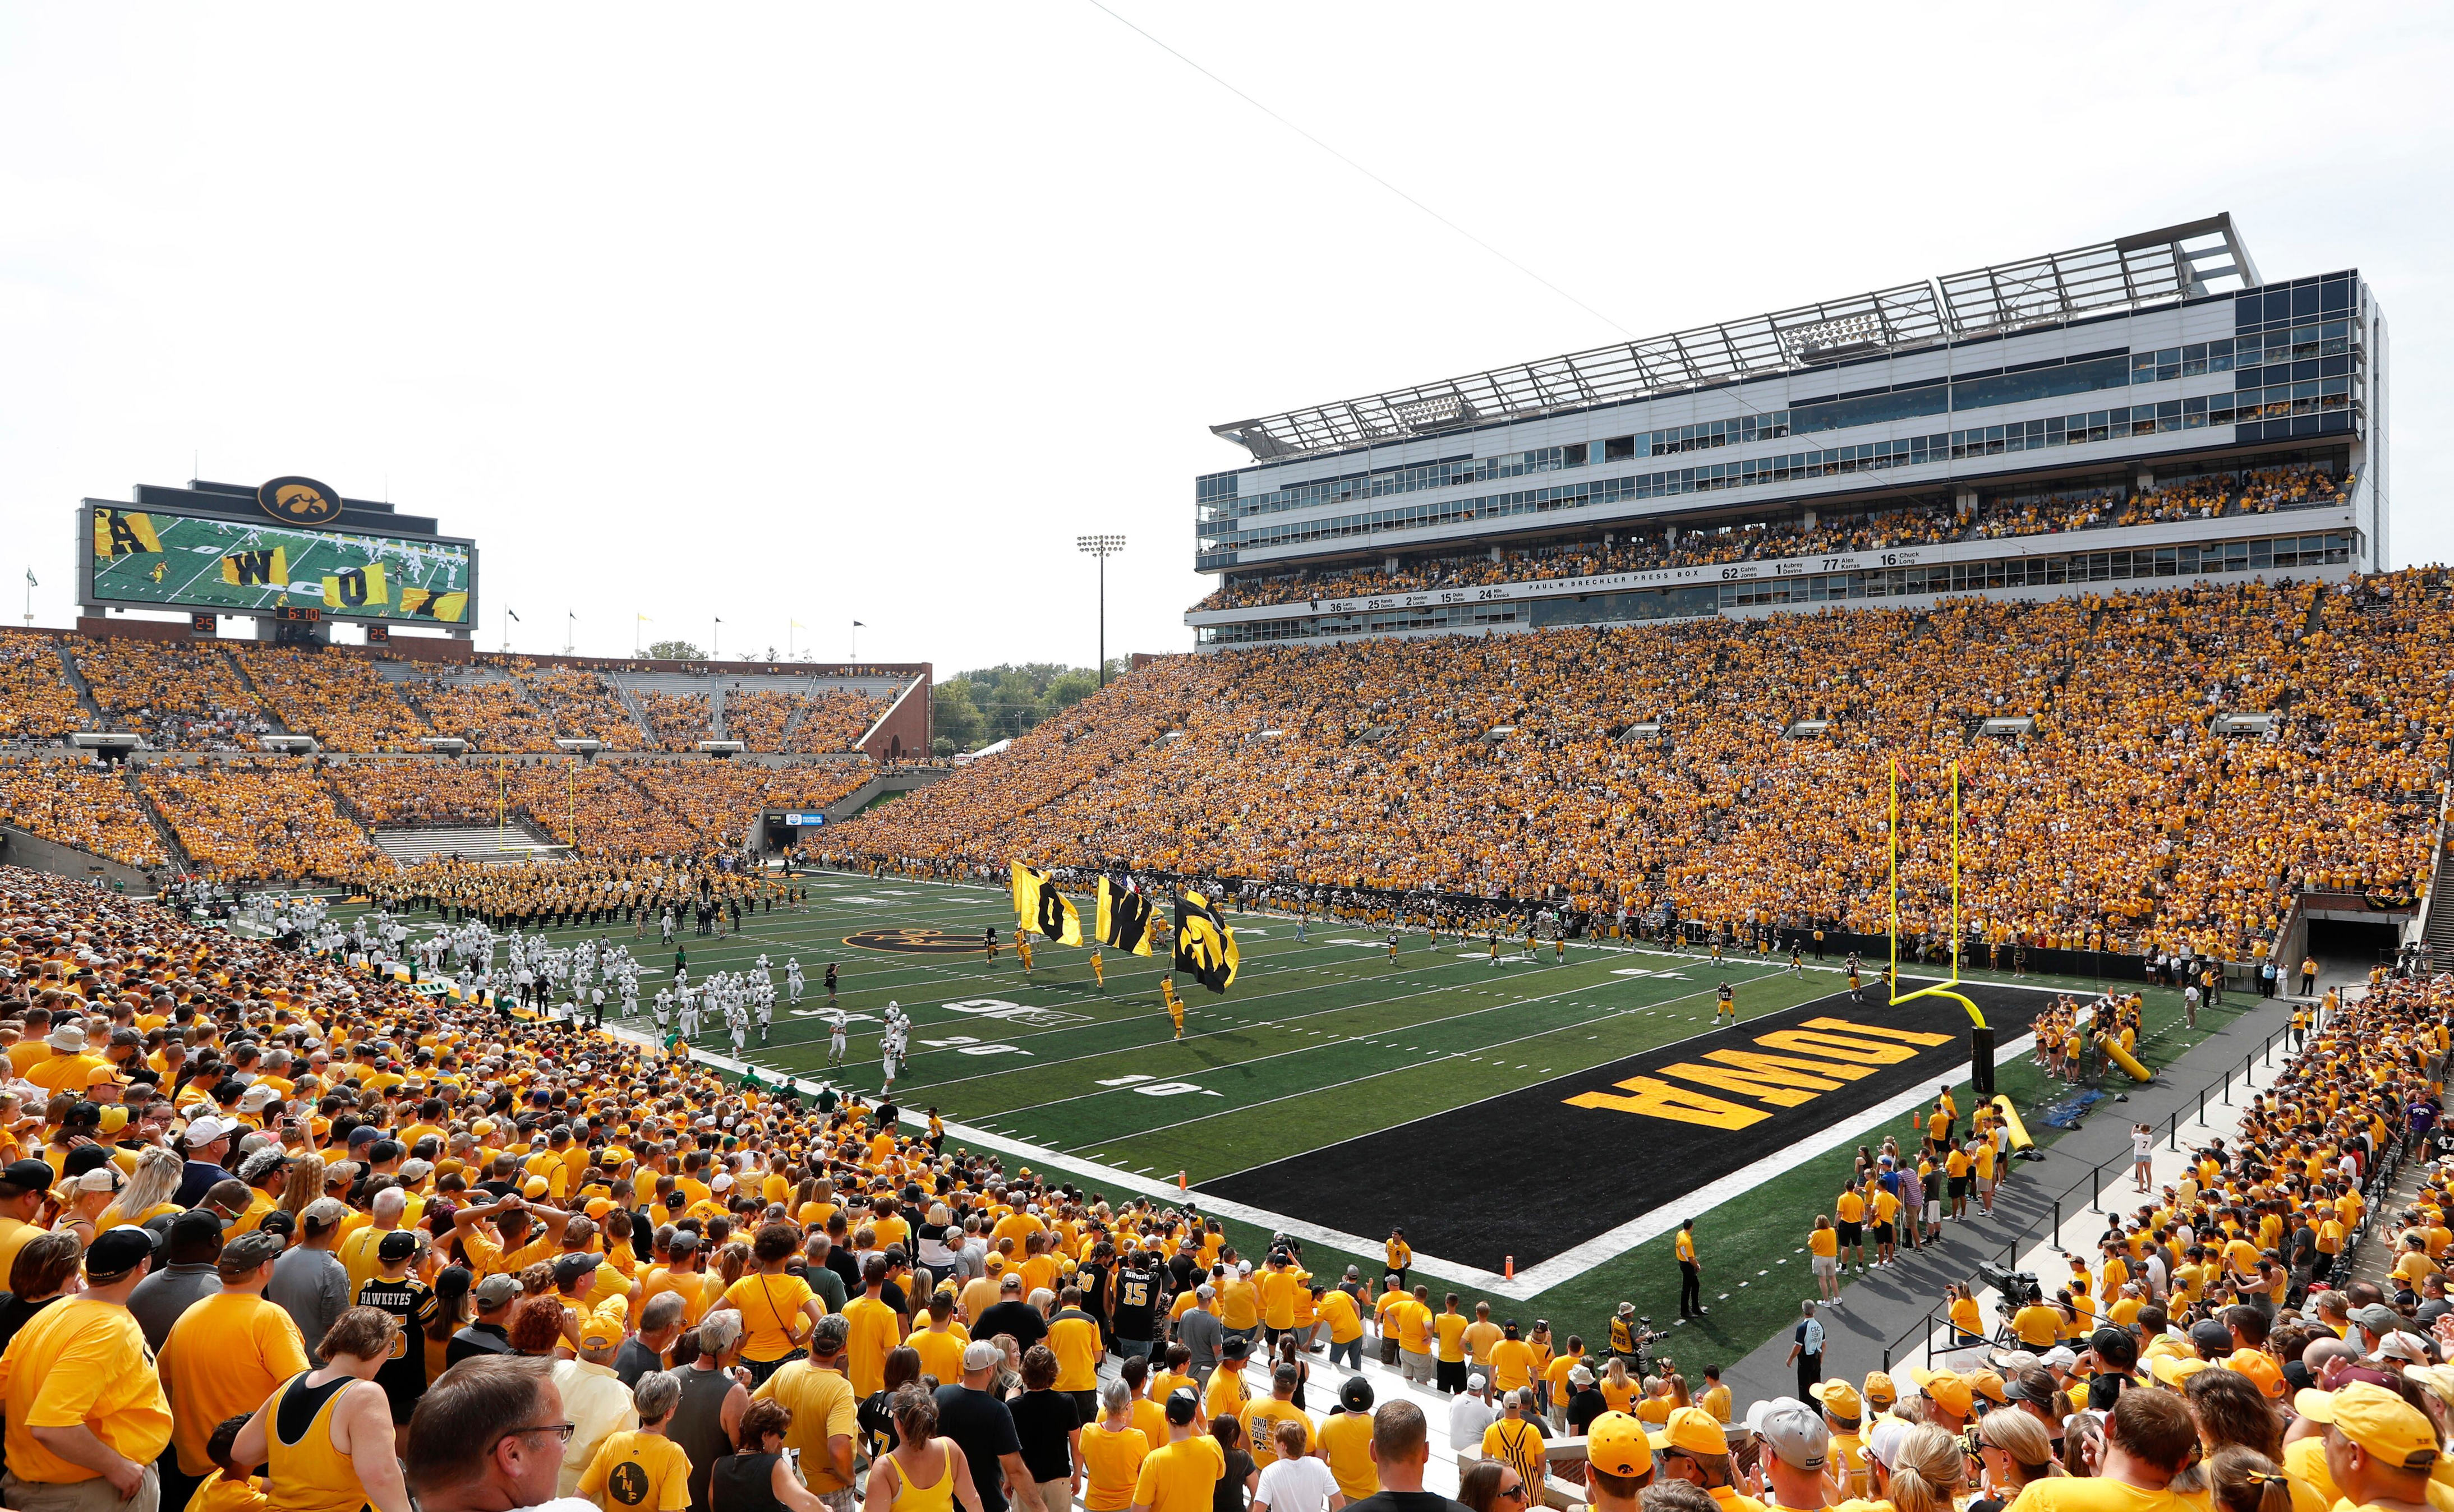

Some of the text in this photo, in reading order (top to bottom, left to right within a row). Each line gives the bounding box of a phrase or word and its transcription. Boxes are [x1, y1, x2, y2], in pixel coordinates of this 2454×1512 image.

[1822, 559, 1839, 570] 77
[1880, 554, 1896, 566] 16
[1722, 568, 1738, 579] 62
[1775, 564, 1781, 574] 1
[1571, 577, 1626, 587] BRECHLER
[1633, 573, 1668, 581] PRESS
[1440, 593, 1451, 603] 15
[1479, 589, 1493, 600] 24
[1330, 603, 1342, 612] 36
[1368, 600, 1379, 609] 25
[1406, 597, 1412, 606] 2
[288, 609, 319, 620] 6:10
[195, 617, 214, 630] 25
[370, 628, 387, 640] 25
[688, 1001, 692, 1009] 9
[1561, 1017, 1956, 1131] IOWA
[1094, 1074, 1203, 1096] 10
[2437, 1136, 2454, 1150] 47
[1076, 1270, 1095, 1293] 20
[361, 1292, 411, 1306] HAWKEYES
[1123, 1281, 1148, 1307] 15
[876, 1403, 894, 1418] IOW
[1251, 1416, 1267, 1429] IOWA
[1251, 1430, 1267, 1441] 2016
[874, 1428, 890, 1459] 7
[615, 1465, 637, 1502] ANF
